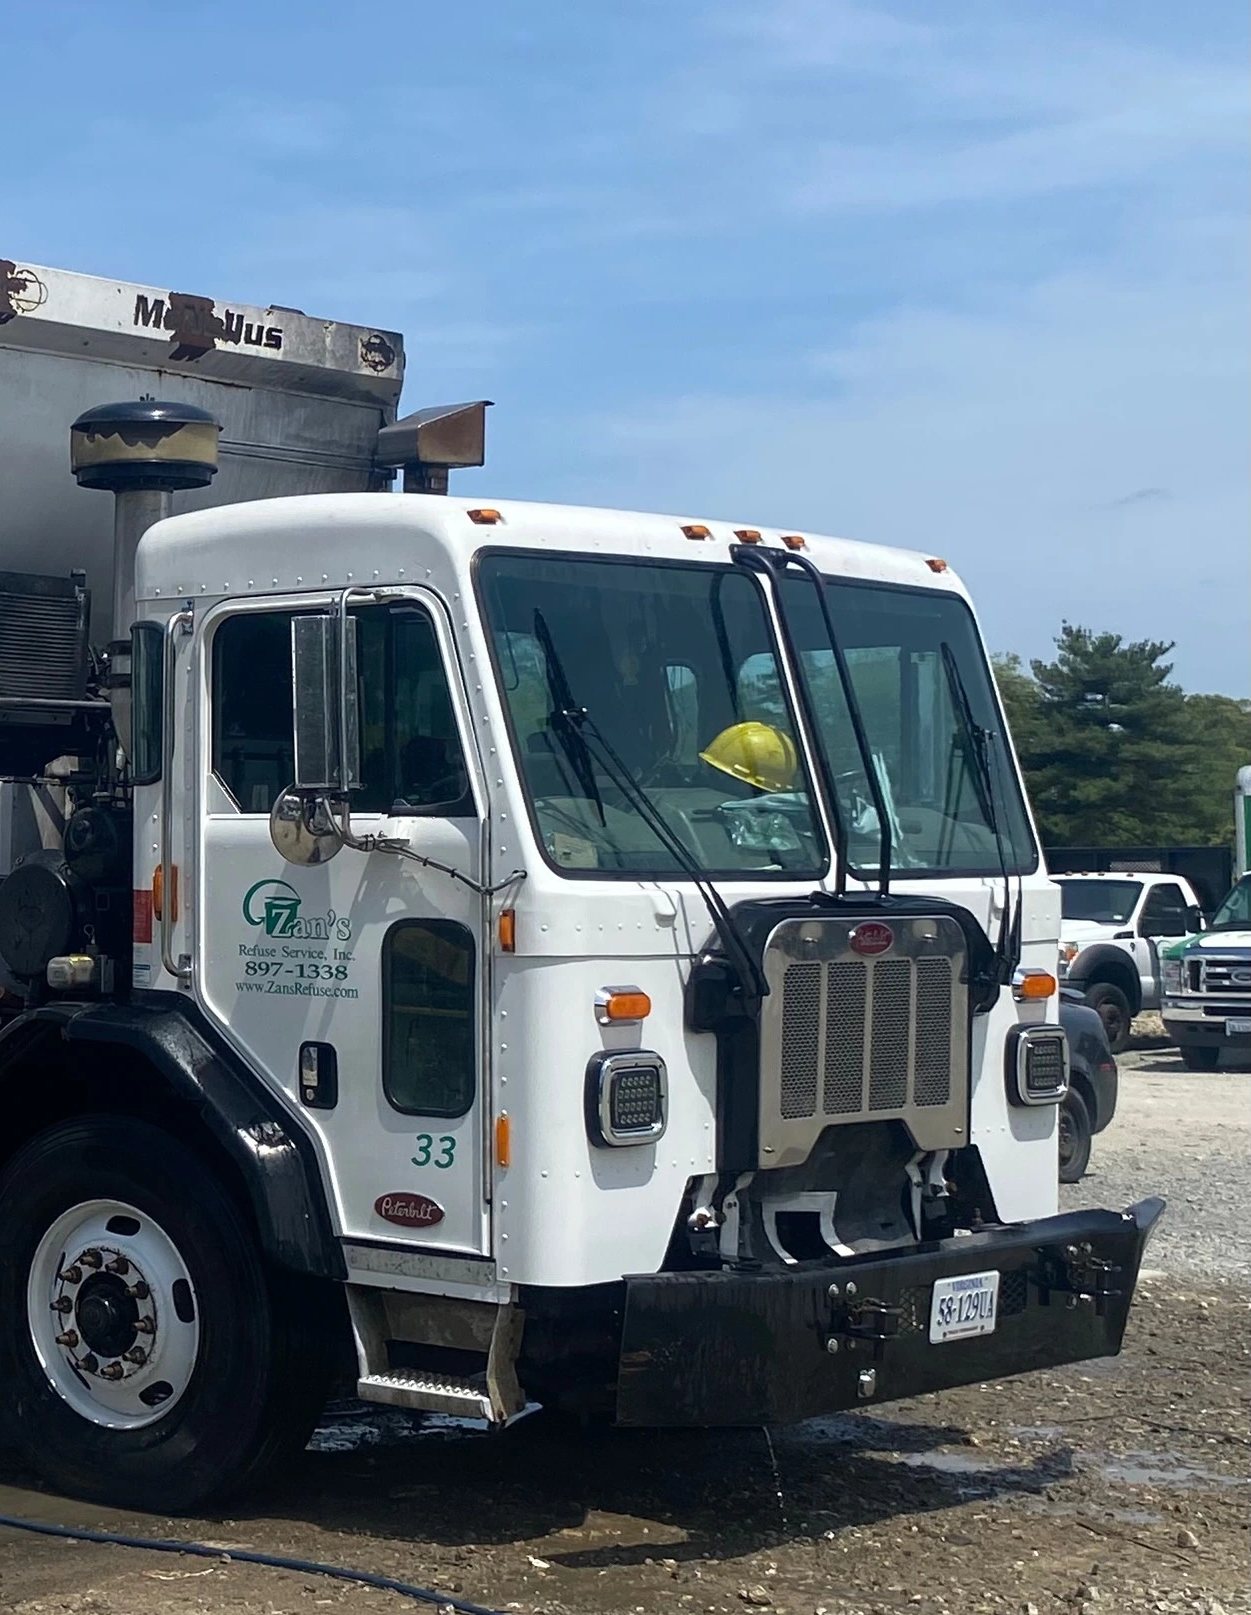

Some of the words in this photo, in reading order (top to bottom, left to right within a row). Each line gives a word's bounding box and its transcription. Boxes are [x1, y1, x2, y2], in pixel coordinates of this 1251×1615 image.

[271, 909, 351, 941] Zan's
[238, 944, 276, 958] Refuse
[282, 945, 327, 961] Service,
[334, 948, 356, 961] Inc.
[245, 960, 348, 981] 897-1338
[235, 981, 359, 999] www.ZansRefuse.com
[411, 1134, 457, 1169] 33
[382, 1197, 437, 1220] Peterbilt
[936, 1289, 994, 1326] 58-129UA
